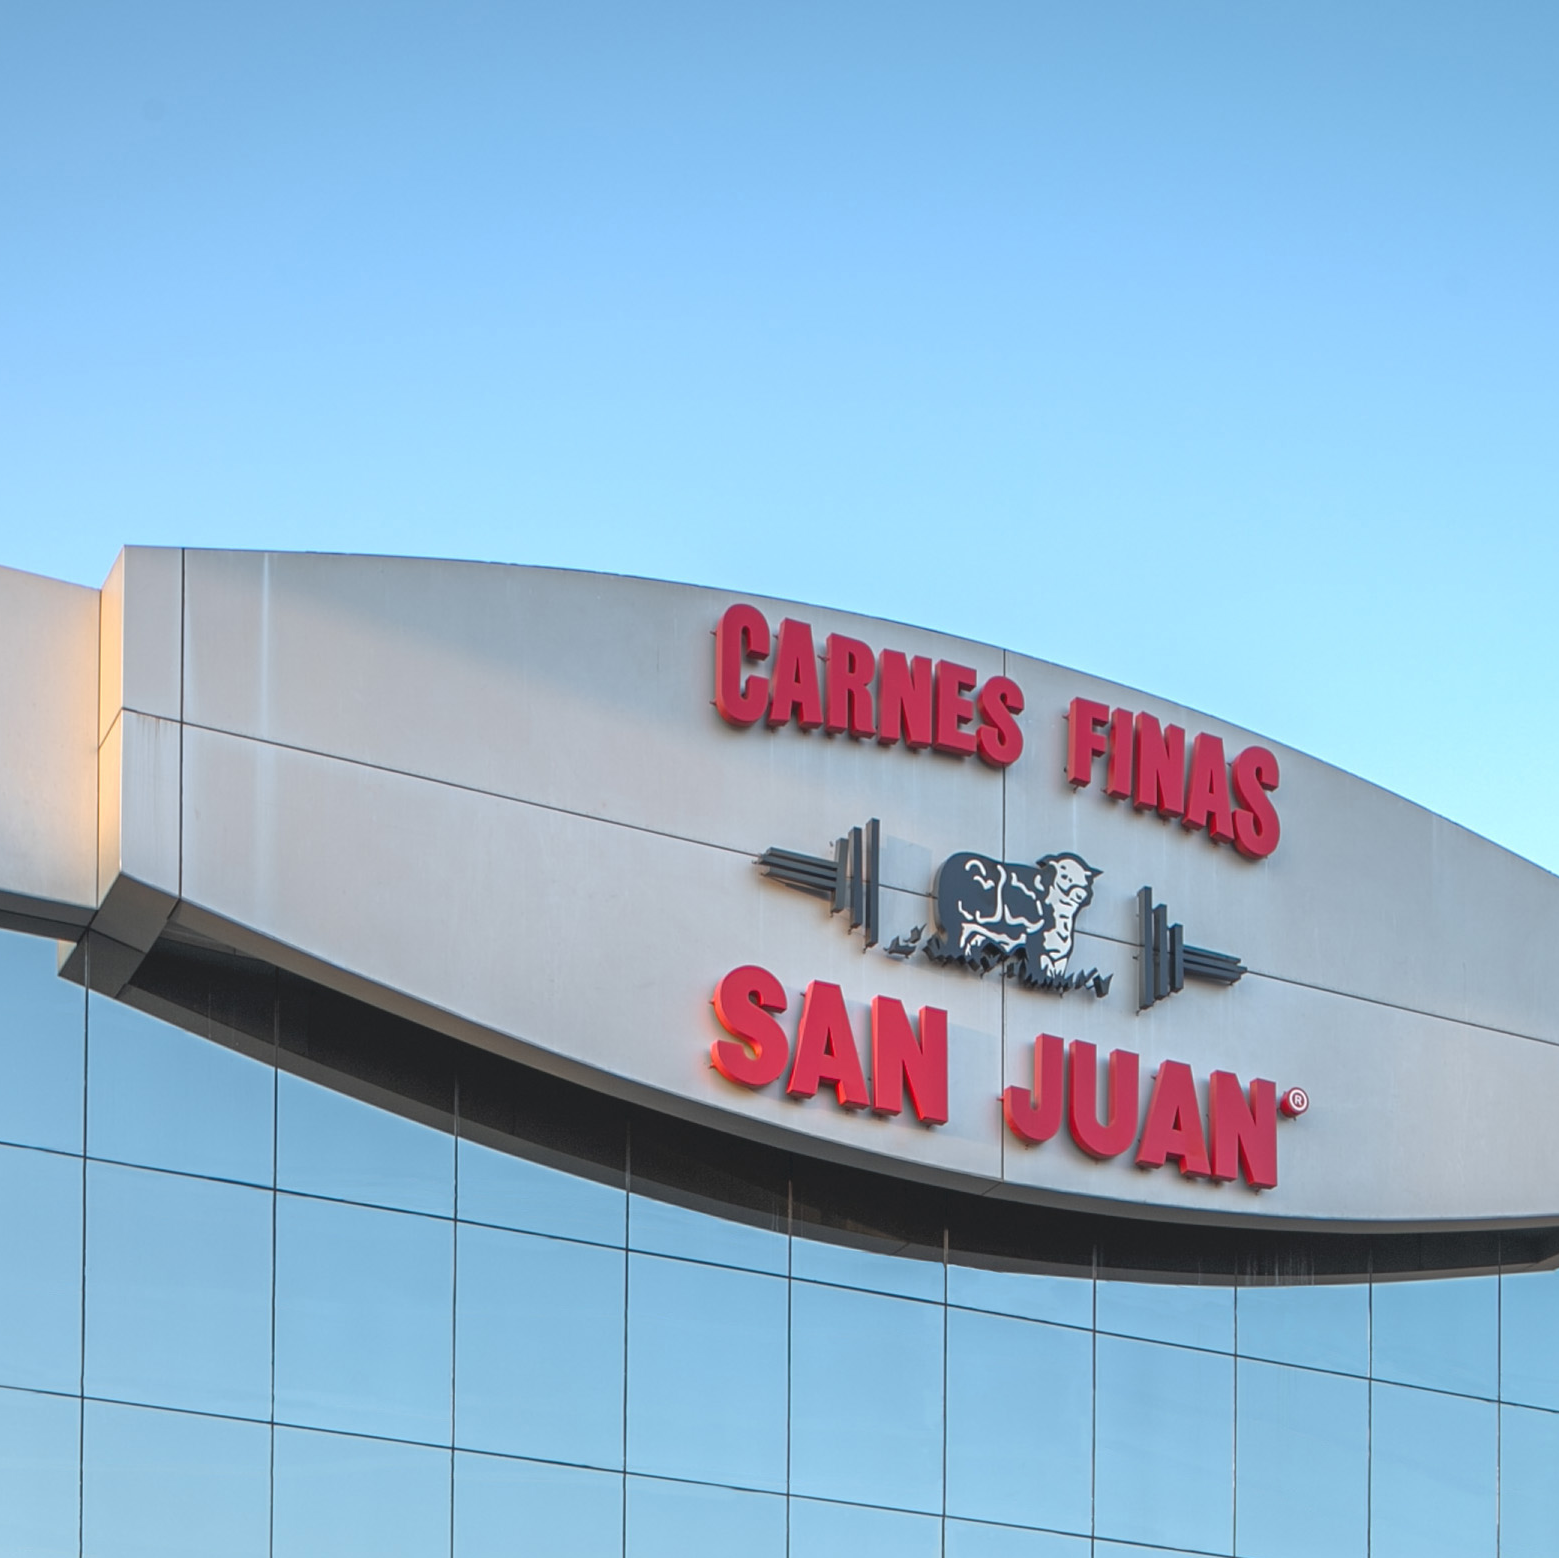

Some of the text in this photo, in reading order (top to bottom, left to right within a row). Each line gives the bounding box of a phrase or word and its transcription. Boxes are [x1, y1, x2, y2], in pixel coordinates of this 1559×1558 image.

[713, 603, 1281, 859] CARNES FINAS
[711, 965, 948, 1127] SAN
[1003, 1033, 1278, 1190] JUAN
